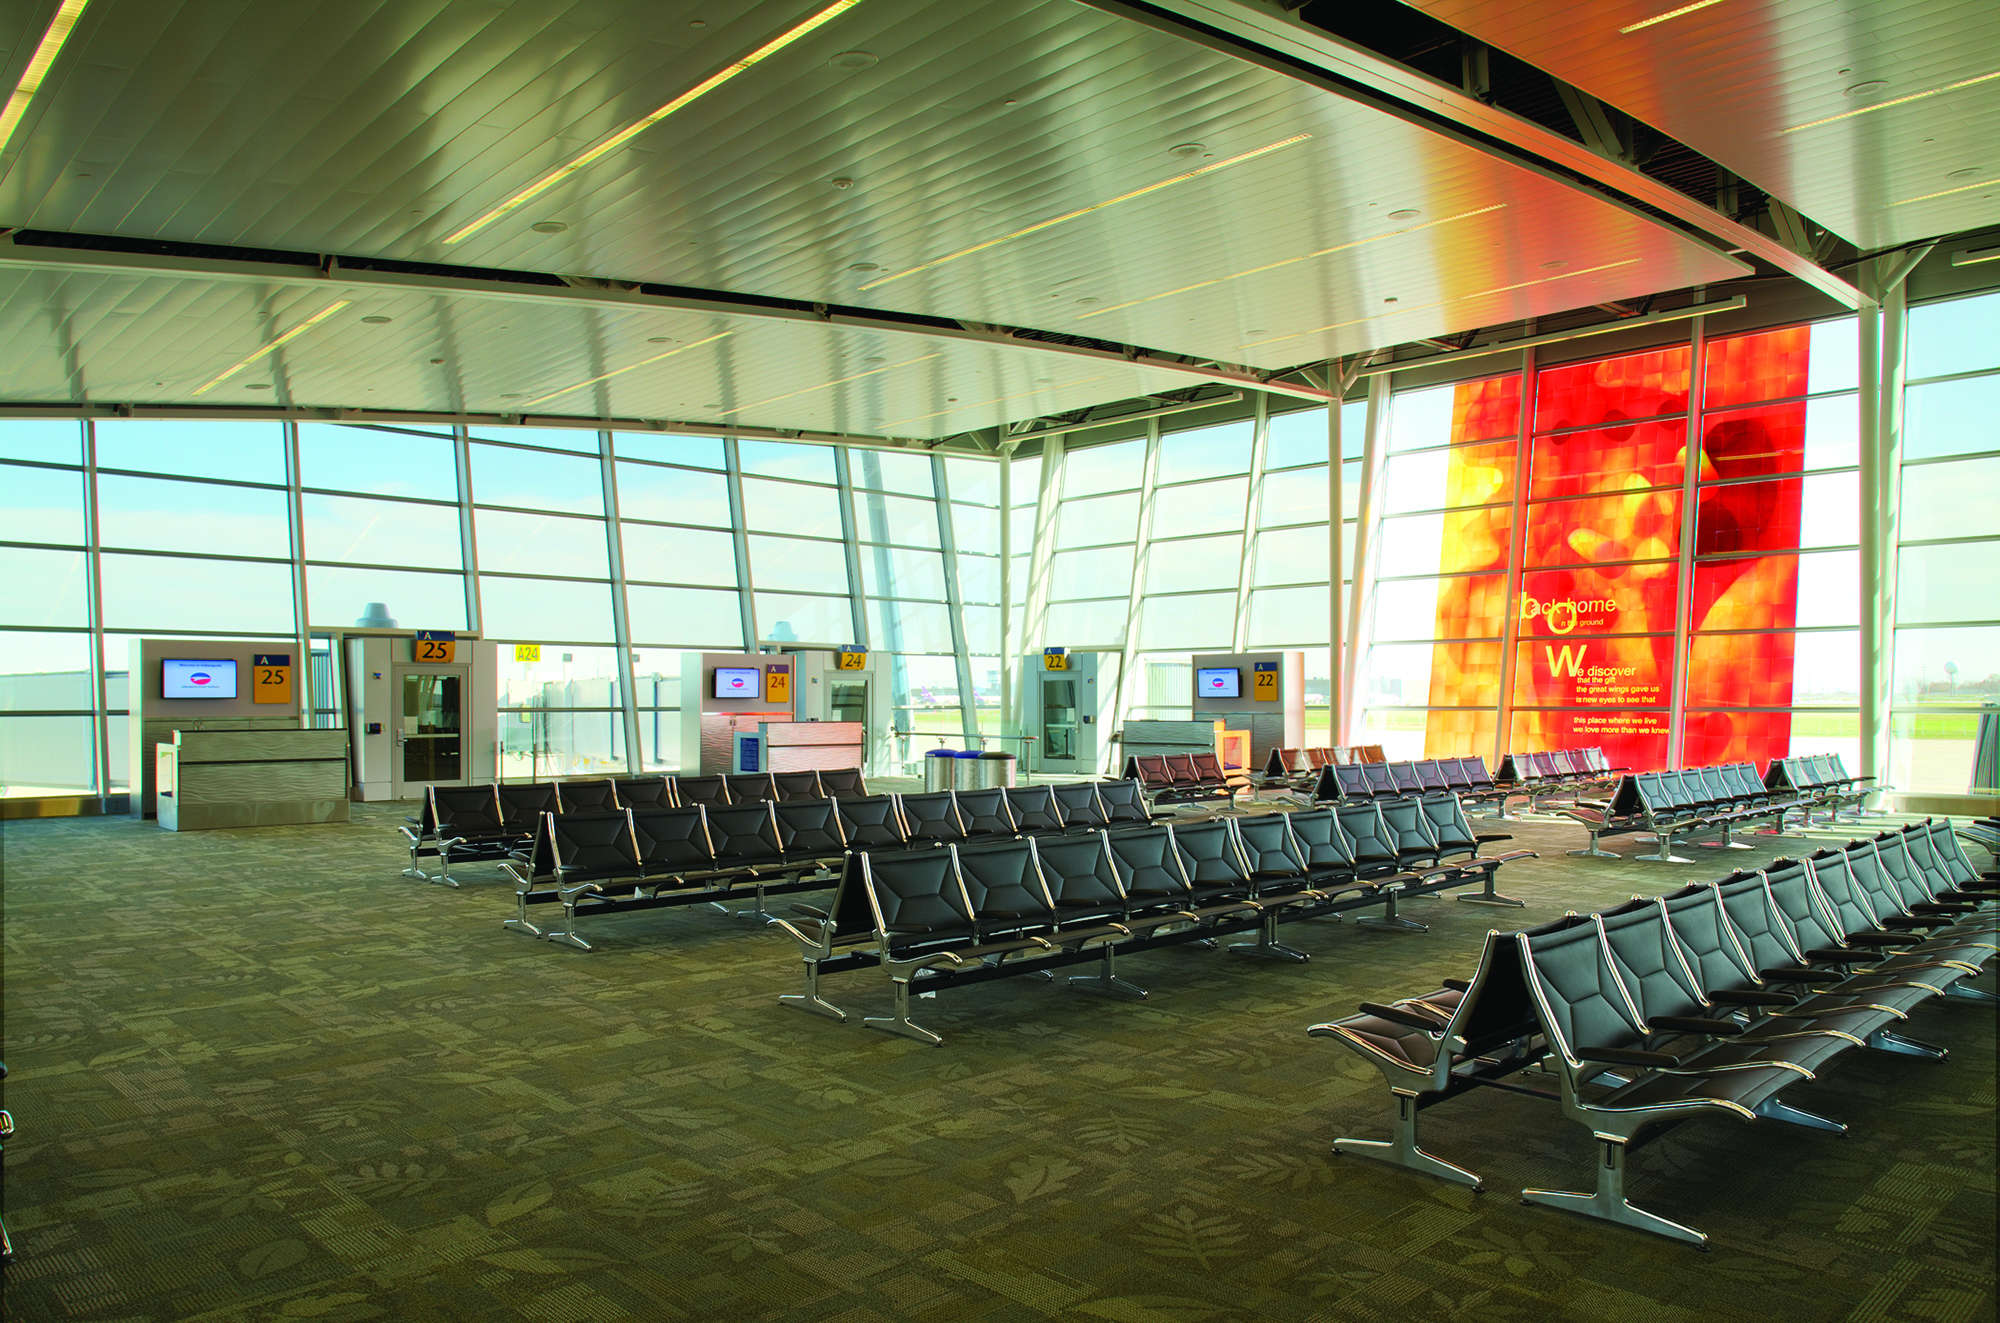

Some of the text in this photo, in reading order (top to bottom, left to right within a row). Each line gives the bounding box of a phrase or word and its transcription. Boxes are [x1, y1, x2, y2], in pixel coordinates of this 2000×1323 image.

[1567, 597, 1617, 614] home
[1580, 618, 1604, 627] ground
[424, 632, 431, 640] A
[422, 642, 447, 658] 25
[519, 646, 538, 660] A24
[261, 656, 269, 664] A
[845, 654, 862, 667] 24
[1048, 656, 1063, 668] 22
[261, 669, 284, 684] 25
[1587, 666, 1636, 676] discover
[770, 676, 785, 688] 24
[1258, 674, 1273, 687] 22
[1609, 686, 1629, 694] wings
[1599, 697, 1617, 705] eyes
